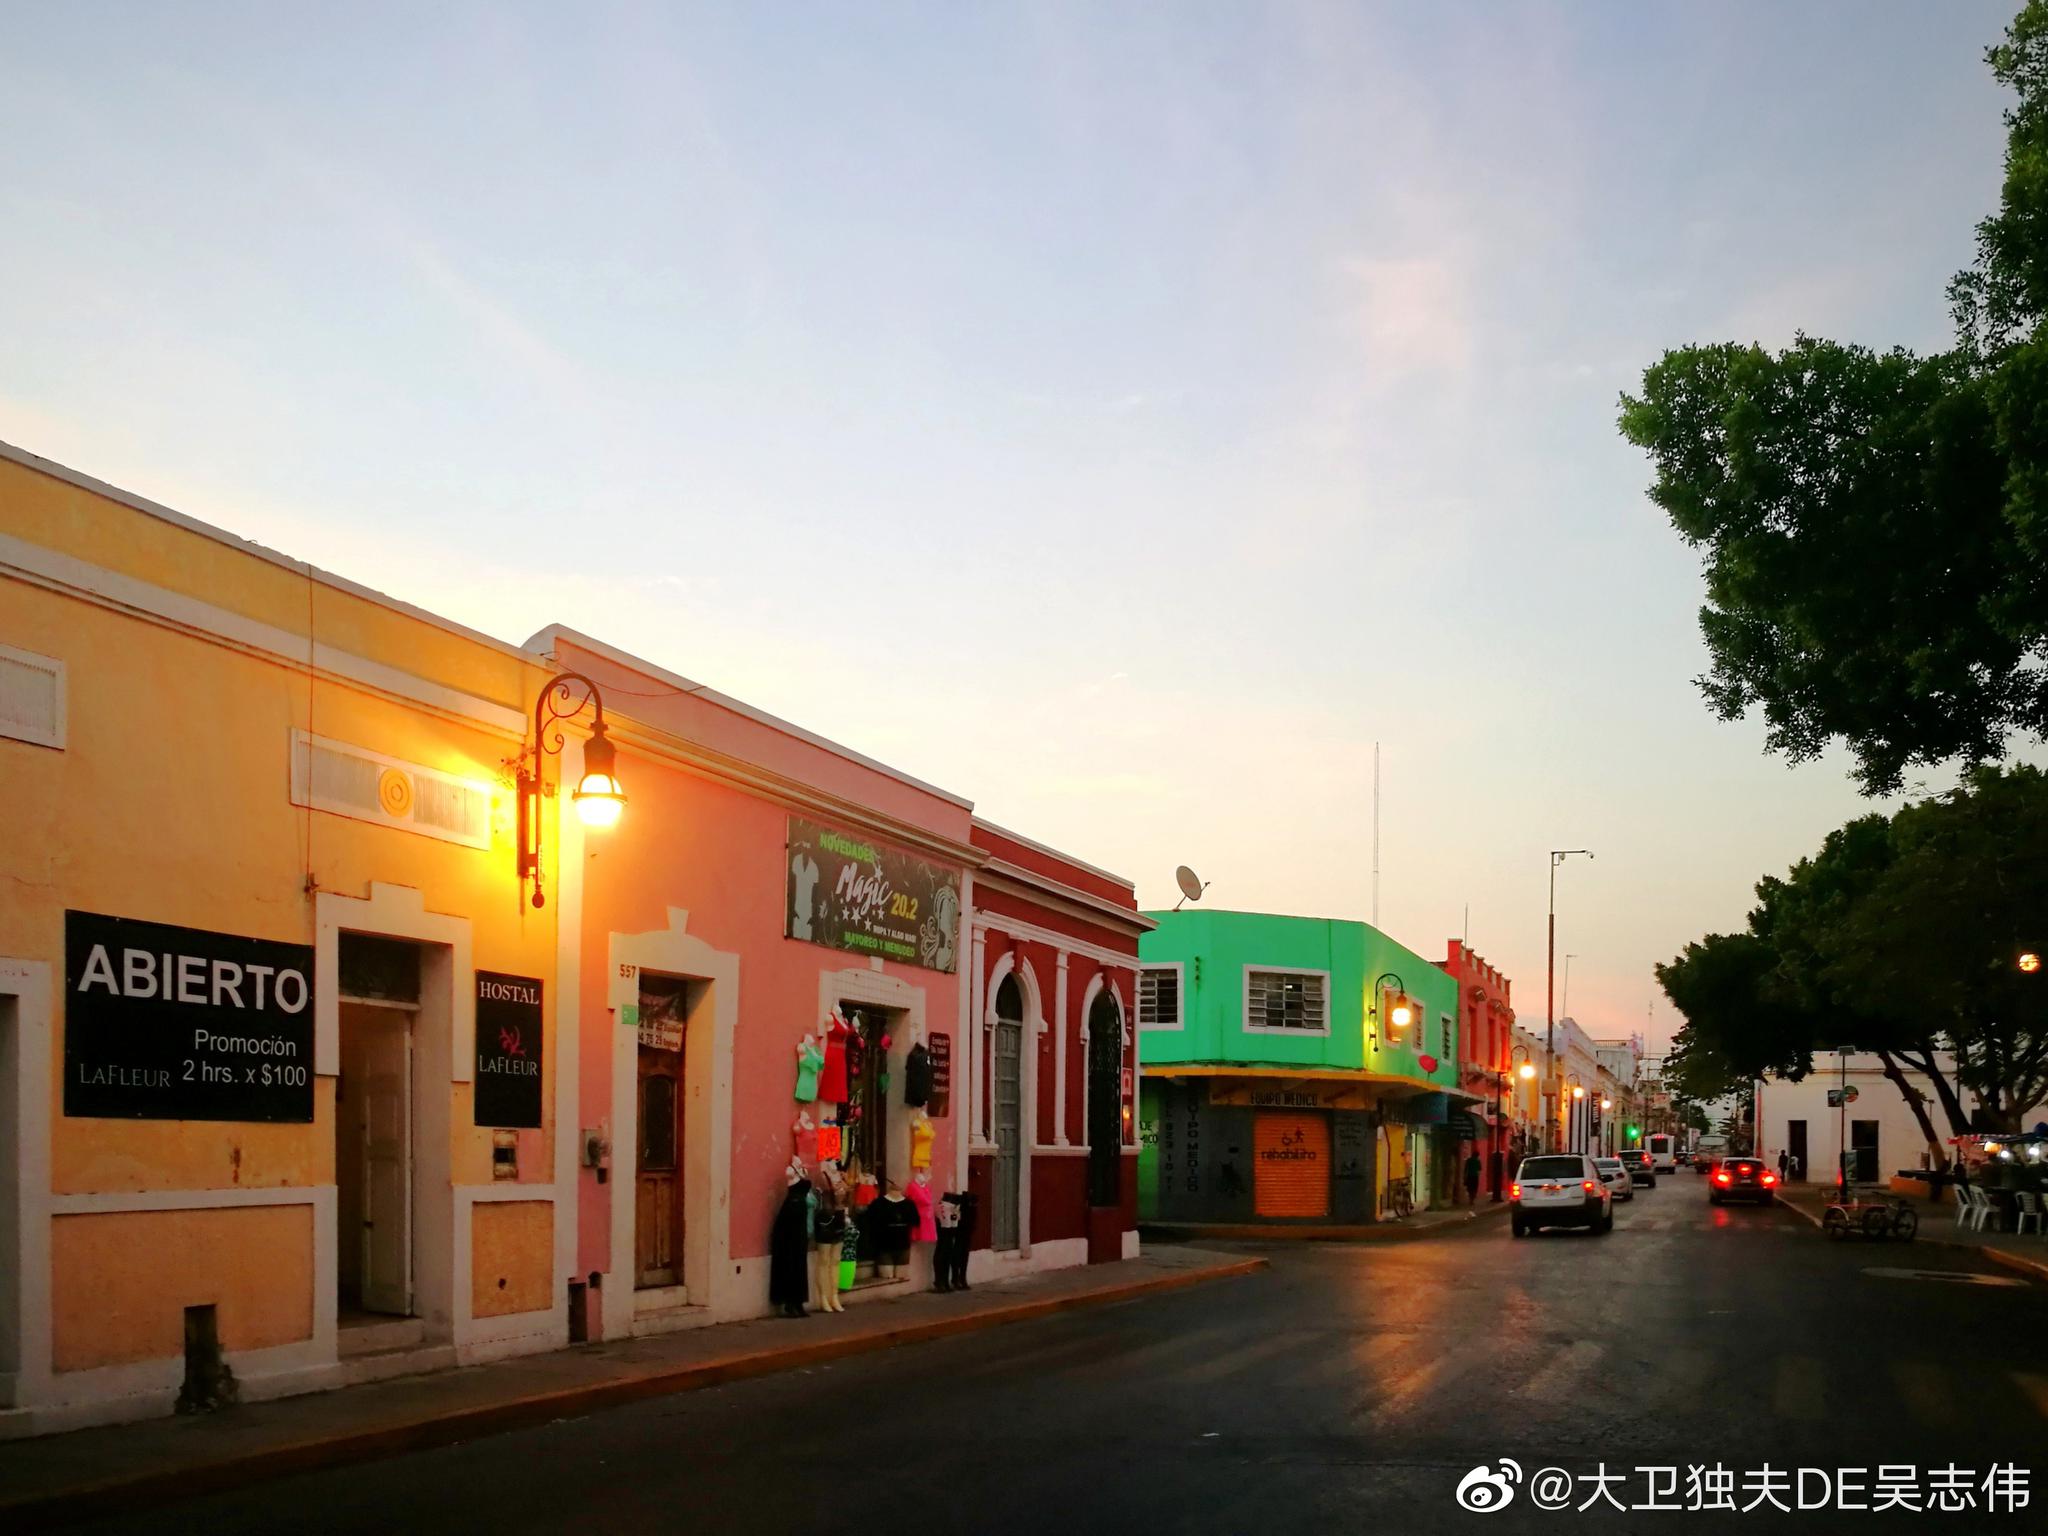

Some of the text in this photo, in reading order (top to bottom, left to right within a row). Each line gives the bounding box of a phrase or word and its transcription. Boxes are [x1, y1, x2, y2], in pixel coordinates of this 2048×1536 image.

[819, 833, 874, 864] NOVEDADES
[835, 862, 893, 915] Magic
[890, 892, 919, 920] 20.2
[844, 931, 878, 949] MAYOREO
[878, 938, 884, 951] Y
[77, 943, 308, 1014] ABIERTO
[620, 964, 637, 979] 557
[480, 981, 540, 1005] HOSTAL
[194, 1029, 297, 1057] Promoción
[182, 1060, 307, 1087] 2 hrs. x $100
